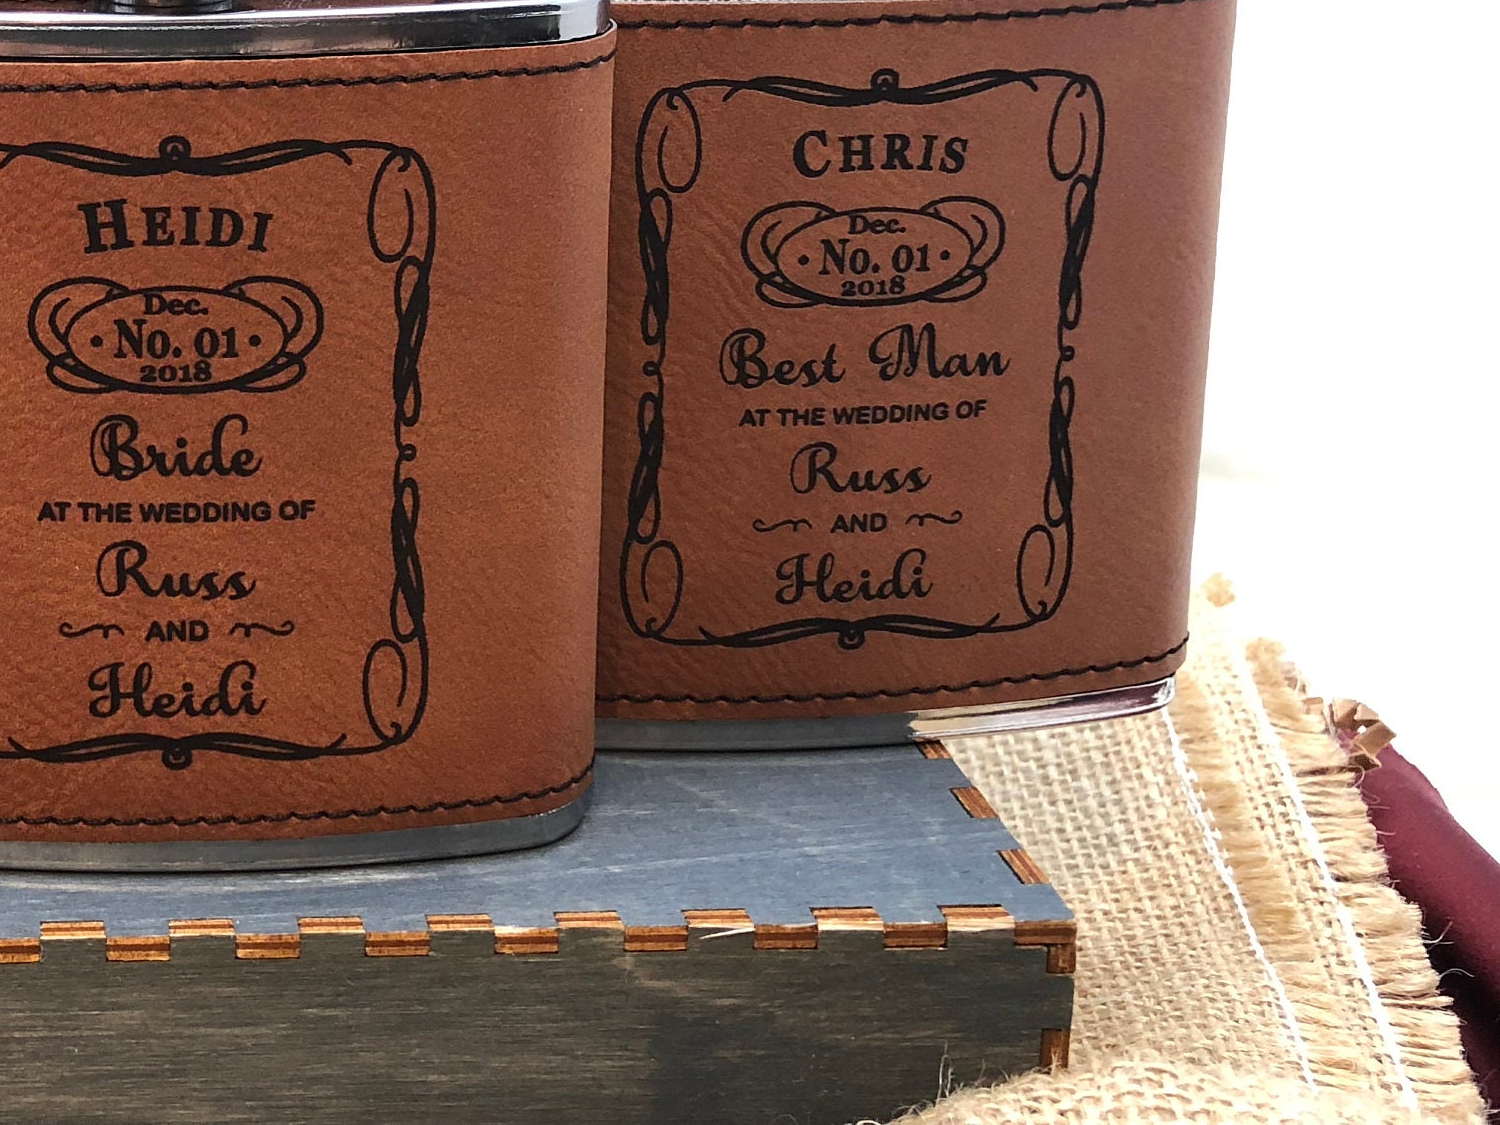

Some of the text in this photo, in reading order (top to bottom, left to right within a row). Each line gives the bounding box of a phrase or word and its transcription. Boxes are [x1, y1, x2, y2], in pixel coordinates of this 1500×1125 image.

[793, 130, 968, 178] CHRIS
[78, 199, 273, 254] HEIDI
[849, 214, 906, 234] Dec.
[819, 239, 930, 275] No. 01
[144, 294, 209, 316] Dec.
[841, 276, 905, 296] 2018
[114, 319, 239, 359] No. 01
[719, 323, 1010, 389] Best Man
[140, 362, 212, 382] 2018
[739, 399, 987, 427] AT THE WEDDING OF
[90, 414, 262, 481] Bride
[790, 441, 931, 494] Russ
[37, 500, 316, 523] AT THE WEDDING OF
[830, 513, 888, 533] AND
[96, 540, 256, 601] Russ
[775, 548, 933, 605] Heidi
[145, 620, 209, 642] AND
[88, 660, 267, 719] Heidi
